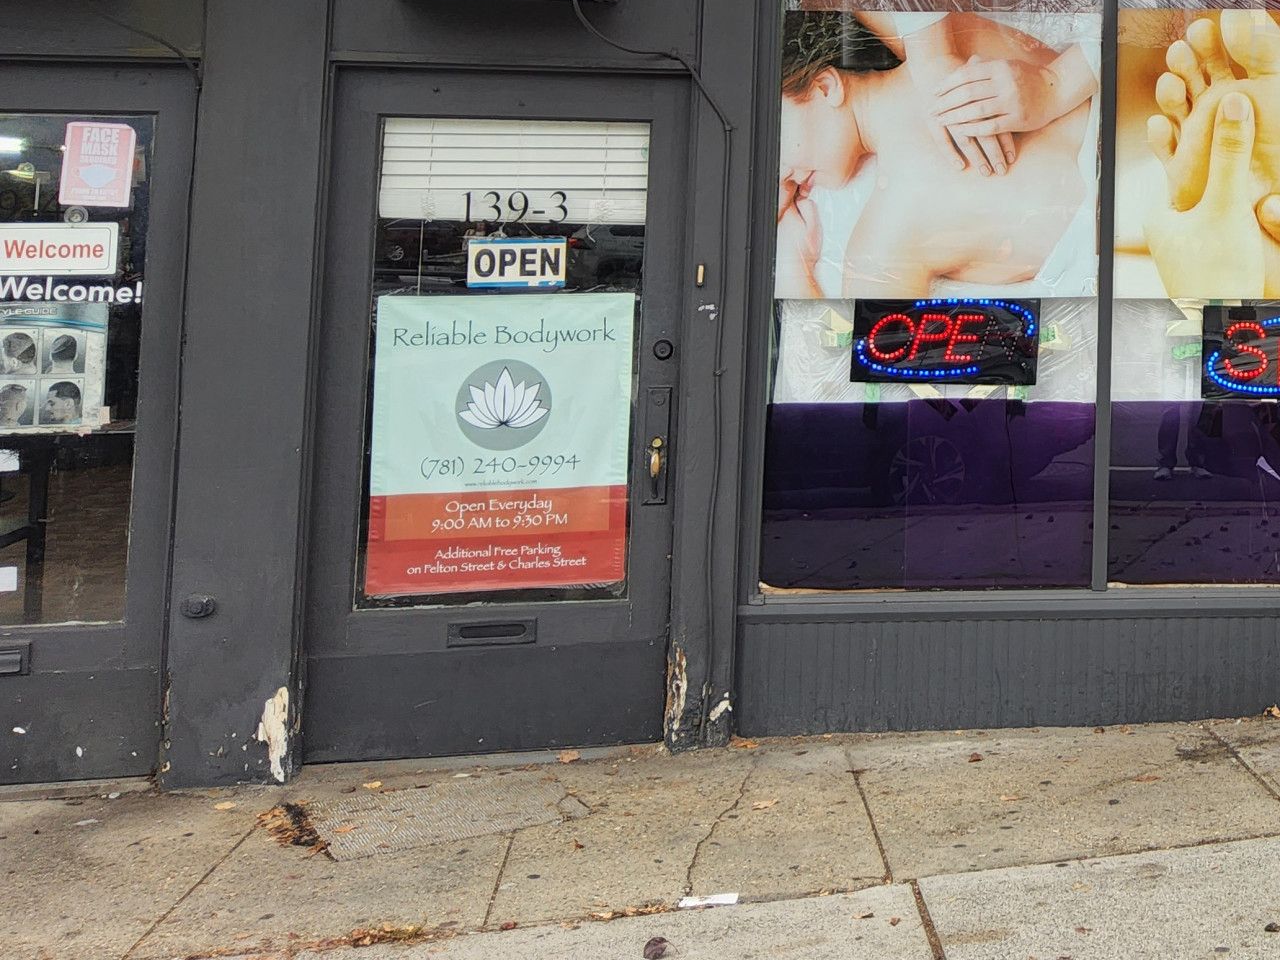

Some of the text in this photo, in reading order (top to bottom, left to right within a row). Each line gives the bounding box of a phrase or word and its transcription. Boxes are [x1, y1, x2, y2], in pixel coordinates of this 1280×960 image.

[82, 127, 120, 143] FACE
[81, 142, 118, 156] MASK
[461, 190, 569, 224] 139-3
[4, 239, 104, 259] Welcome
[474, 248, 561, 278] OPEN
[0, 276, 143, 304] Welcome!
[393, 317, 616, 353] Reliable Bodywork
[420, 453, 581, 480] (781) 240-9994
[445, 494, 553, 518] Open Everyday
[431, 513, 569, 533] 9:00 AM to 9:30 PM
[434, 542, 562, 560] Additional Free Parking
[406, 556, 588, 575] on Felton Street & Charles Street
